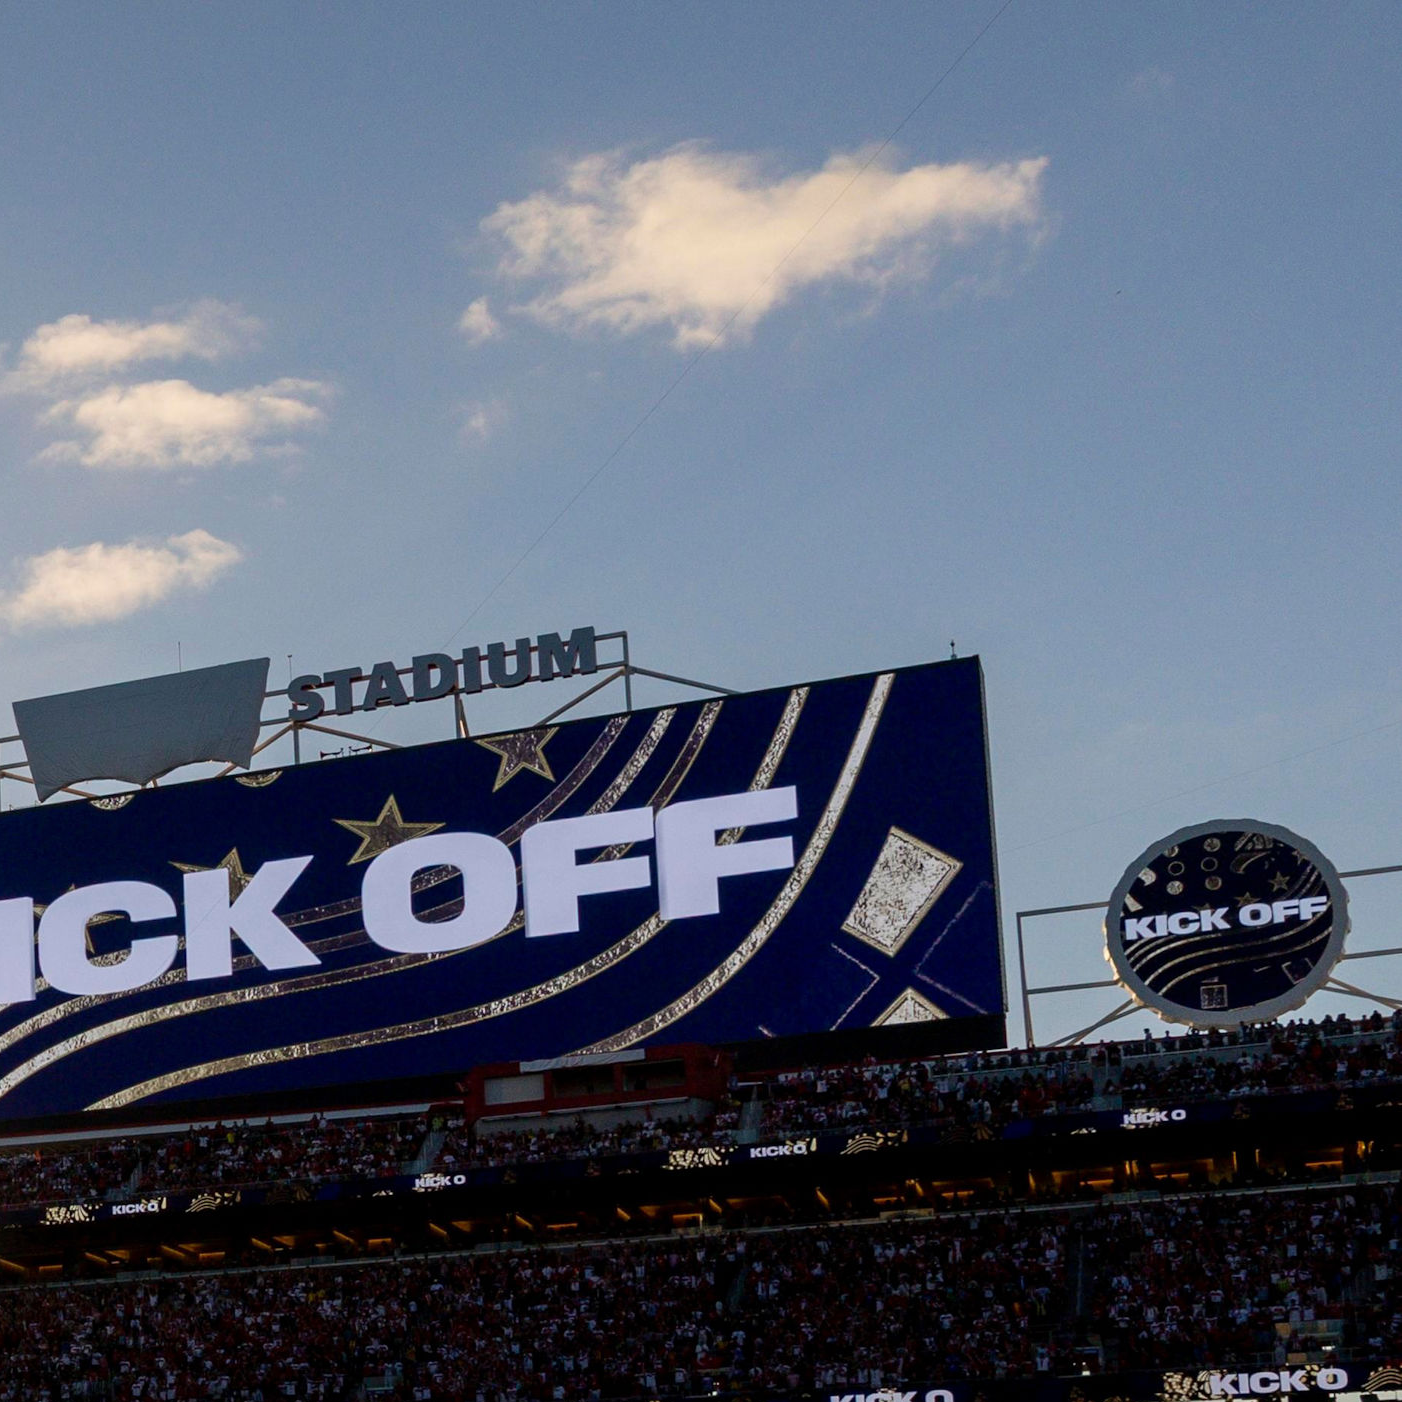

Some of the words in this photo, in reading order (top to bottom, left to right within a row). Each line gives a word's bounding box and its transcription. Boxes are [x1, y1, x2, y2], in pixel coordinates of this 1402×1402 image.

[287, 626, 598, 722] STADIUM
[361, 785, 798, 954] OFF
[1124, 906, 1231, 941] KICK
[1238, 896, 1328, 927] OFF
[1170, 1108, 1187, 1121] O
[749, 1145, 792, 1159] KICK
[793, 1144, 807, 1155] O
[453, 1174, 467, 1185] O
[112, 1204, 147, 1215] KICK
[147, 1202, 159, 1212] O
[1209, 1370, 1310, 1396] KICK
[1316, 1368, 1349, 1391] O
